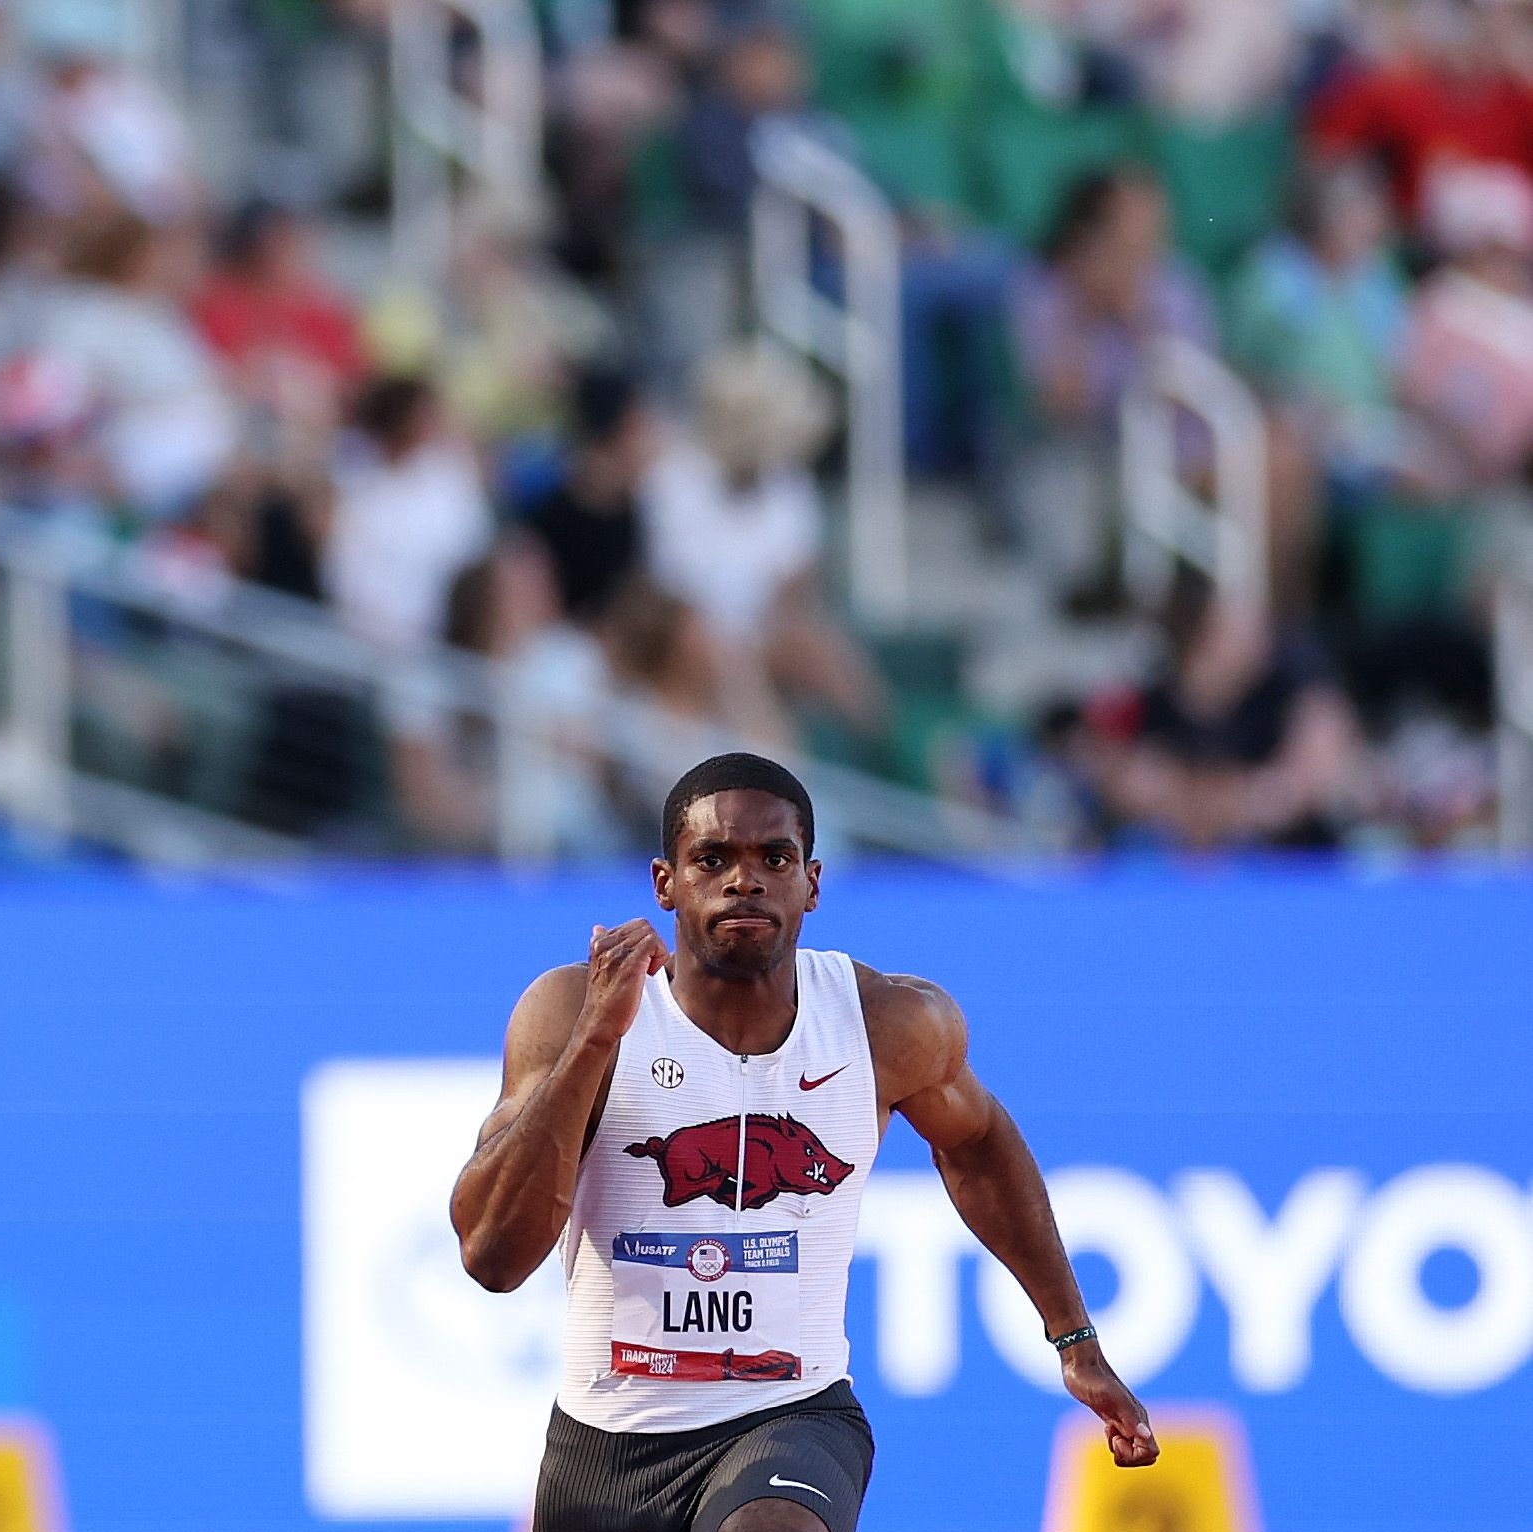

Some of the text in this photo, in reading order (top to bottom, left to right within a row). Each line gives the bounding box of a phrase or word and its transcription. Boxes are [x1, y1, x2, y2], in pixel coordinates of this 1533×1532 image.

[654, 1060, 683, 1087] SEC
[759, 1236, 790, 1248] OLYMPIC
[640, 1245, 677, 1256] USATF
[742, 1247, 791, 1260] TEAM TRIALS
[663, 1290, 753, 1333] LANG
[620, 1349, 677, 1364] TRACKTOWN
[649, 1362, 675, 1374] 2024
